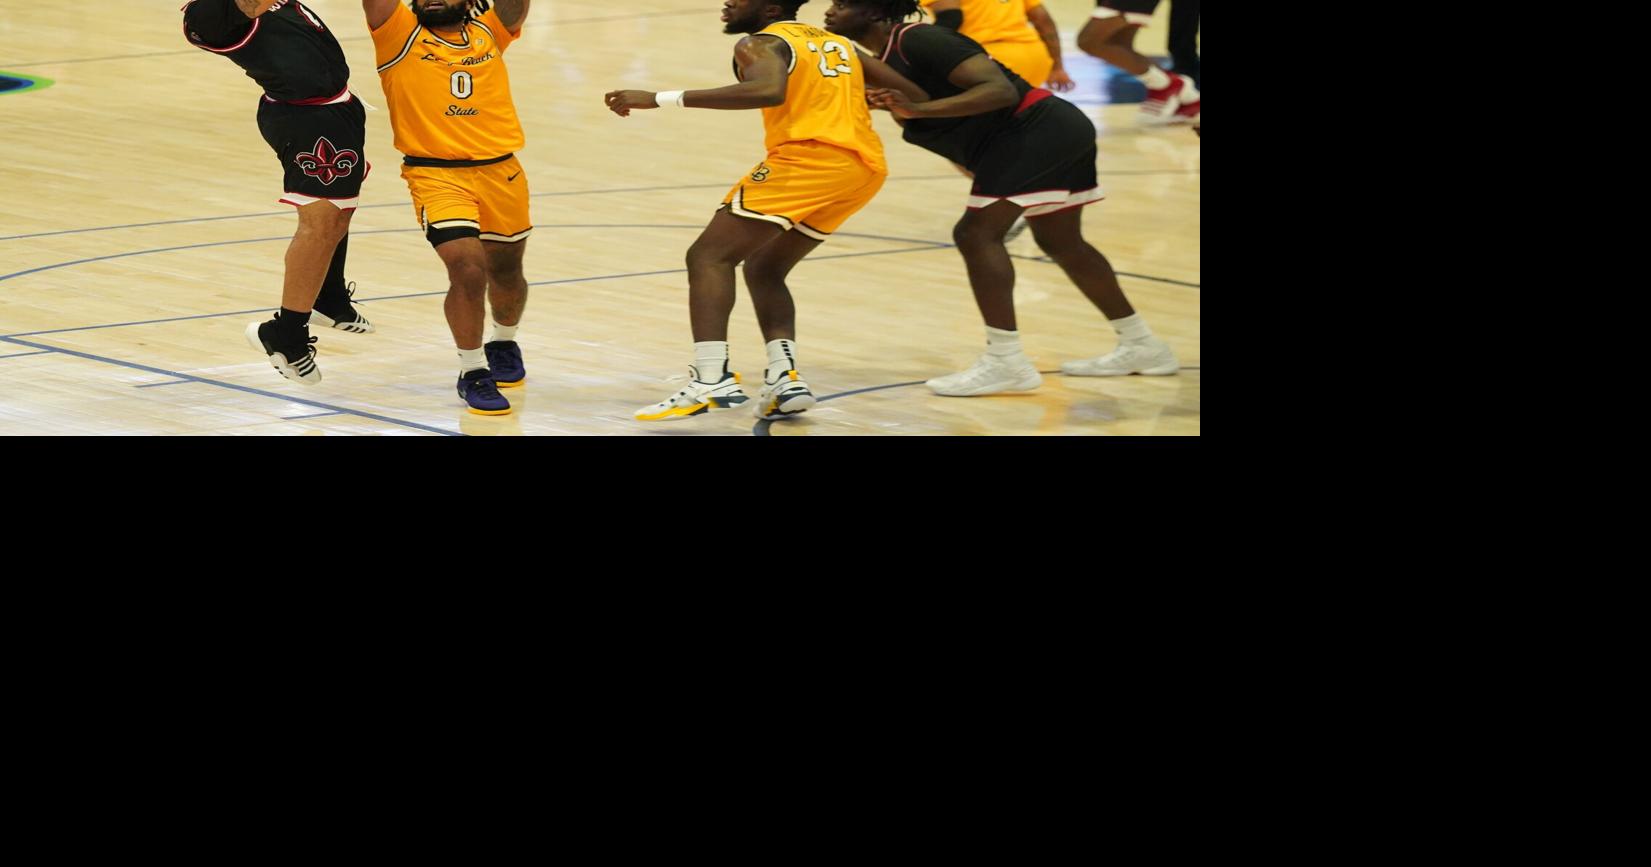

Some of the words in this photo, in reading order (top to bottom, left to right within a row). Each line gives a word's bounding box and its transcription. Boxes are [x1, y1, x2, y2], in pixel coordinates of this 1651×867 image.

[461, 53, 494, 66] Beach
[806, 40, 852, 78] 23
[450, 70, 473, 99] 0
[445, 104, 479, 116] State
